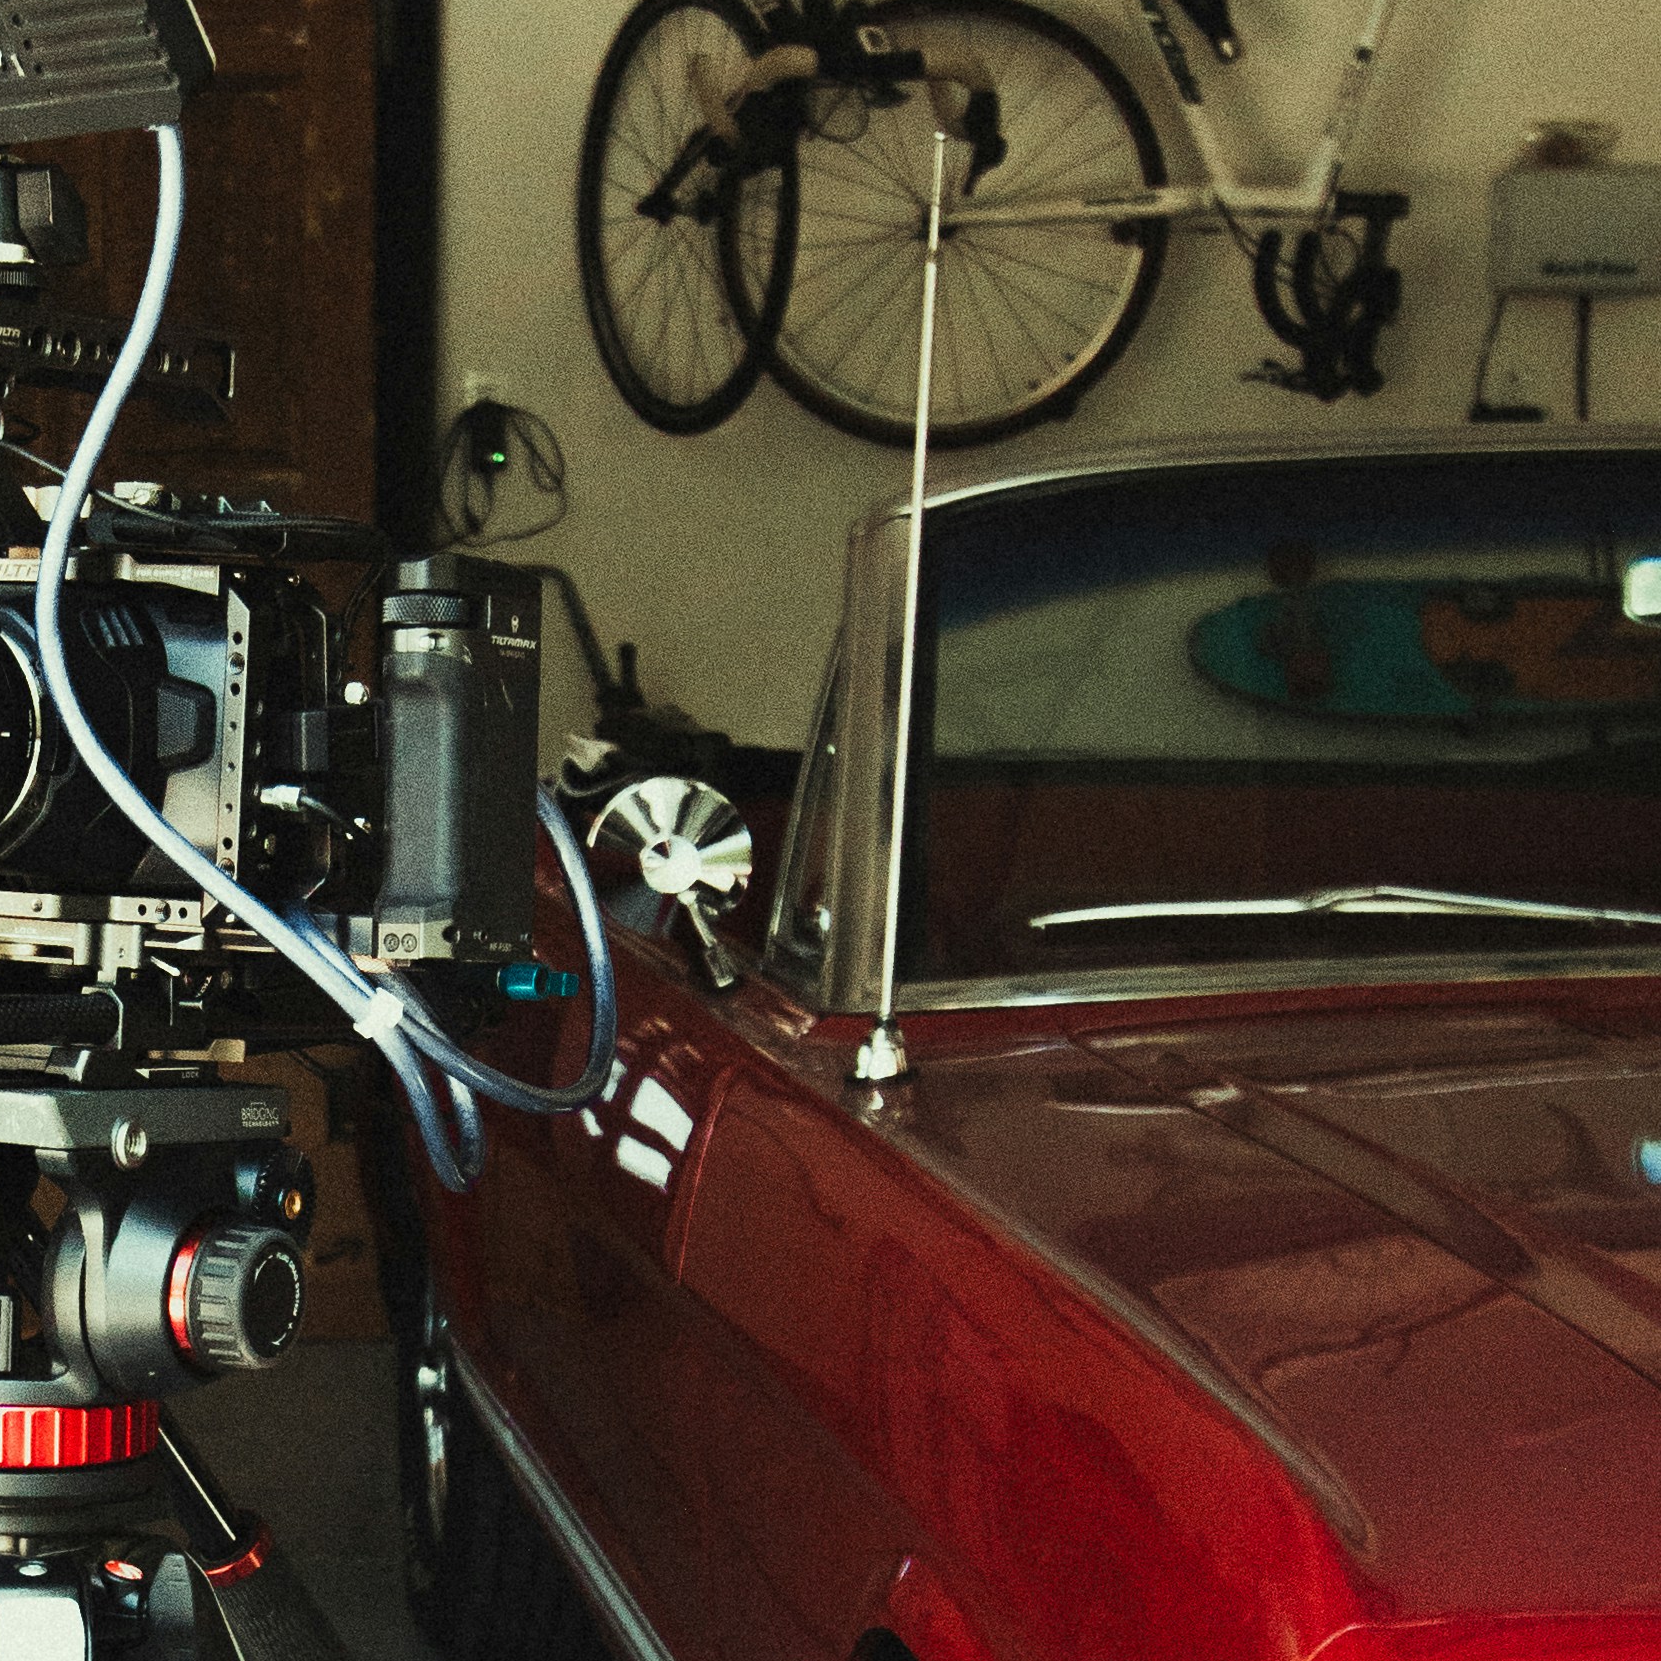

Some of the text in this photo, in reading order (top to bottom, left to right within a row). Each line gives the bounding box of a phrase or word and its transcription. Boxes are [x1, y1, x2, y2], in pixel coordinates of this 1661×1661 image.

[491, 634, 537, 650] TILTAMAX
[181, 1070, 200, 1079] LOCK
[241, 1102, 280, 1121] BRIDGING
